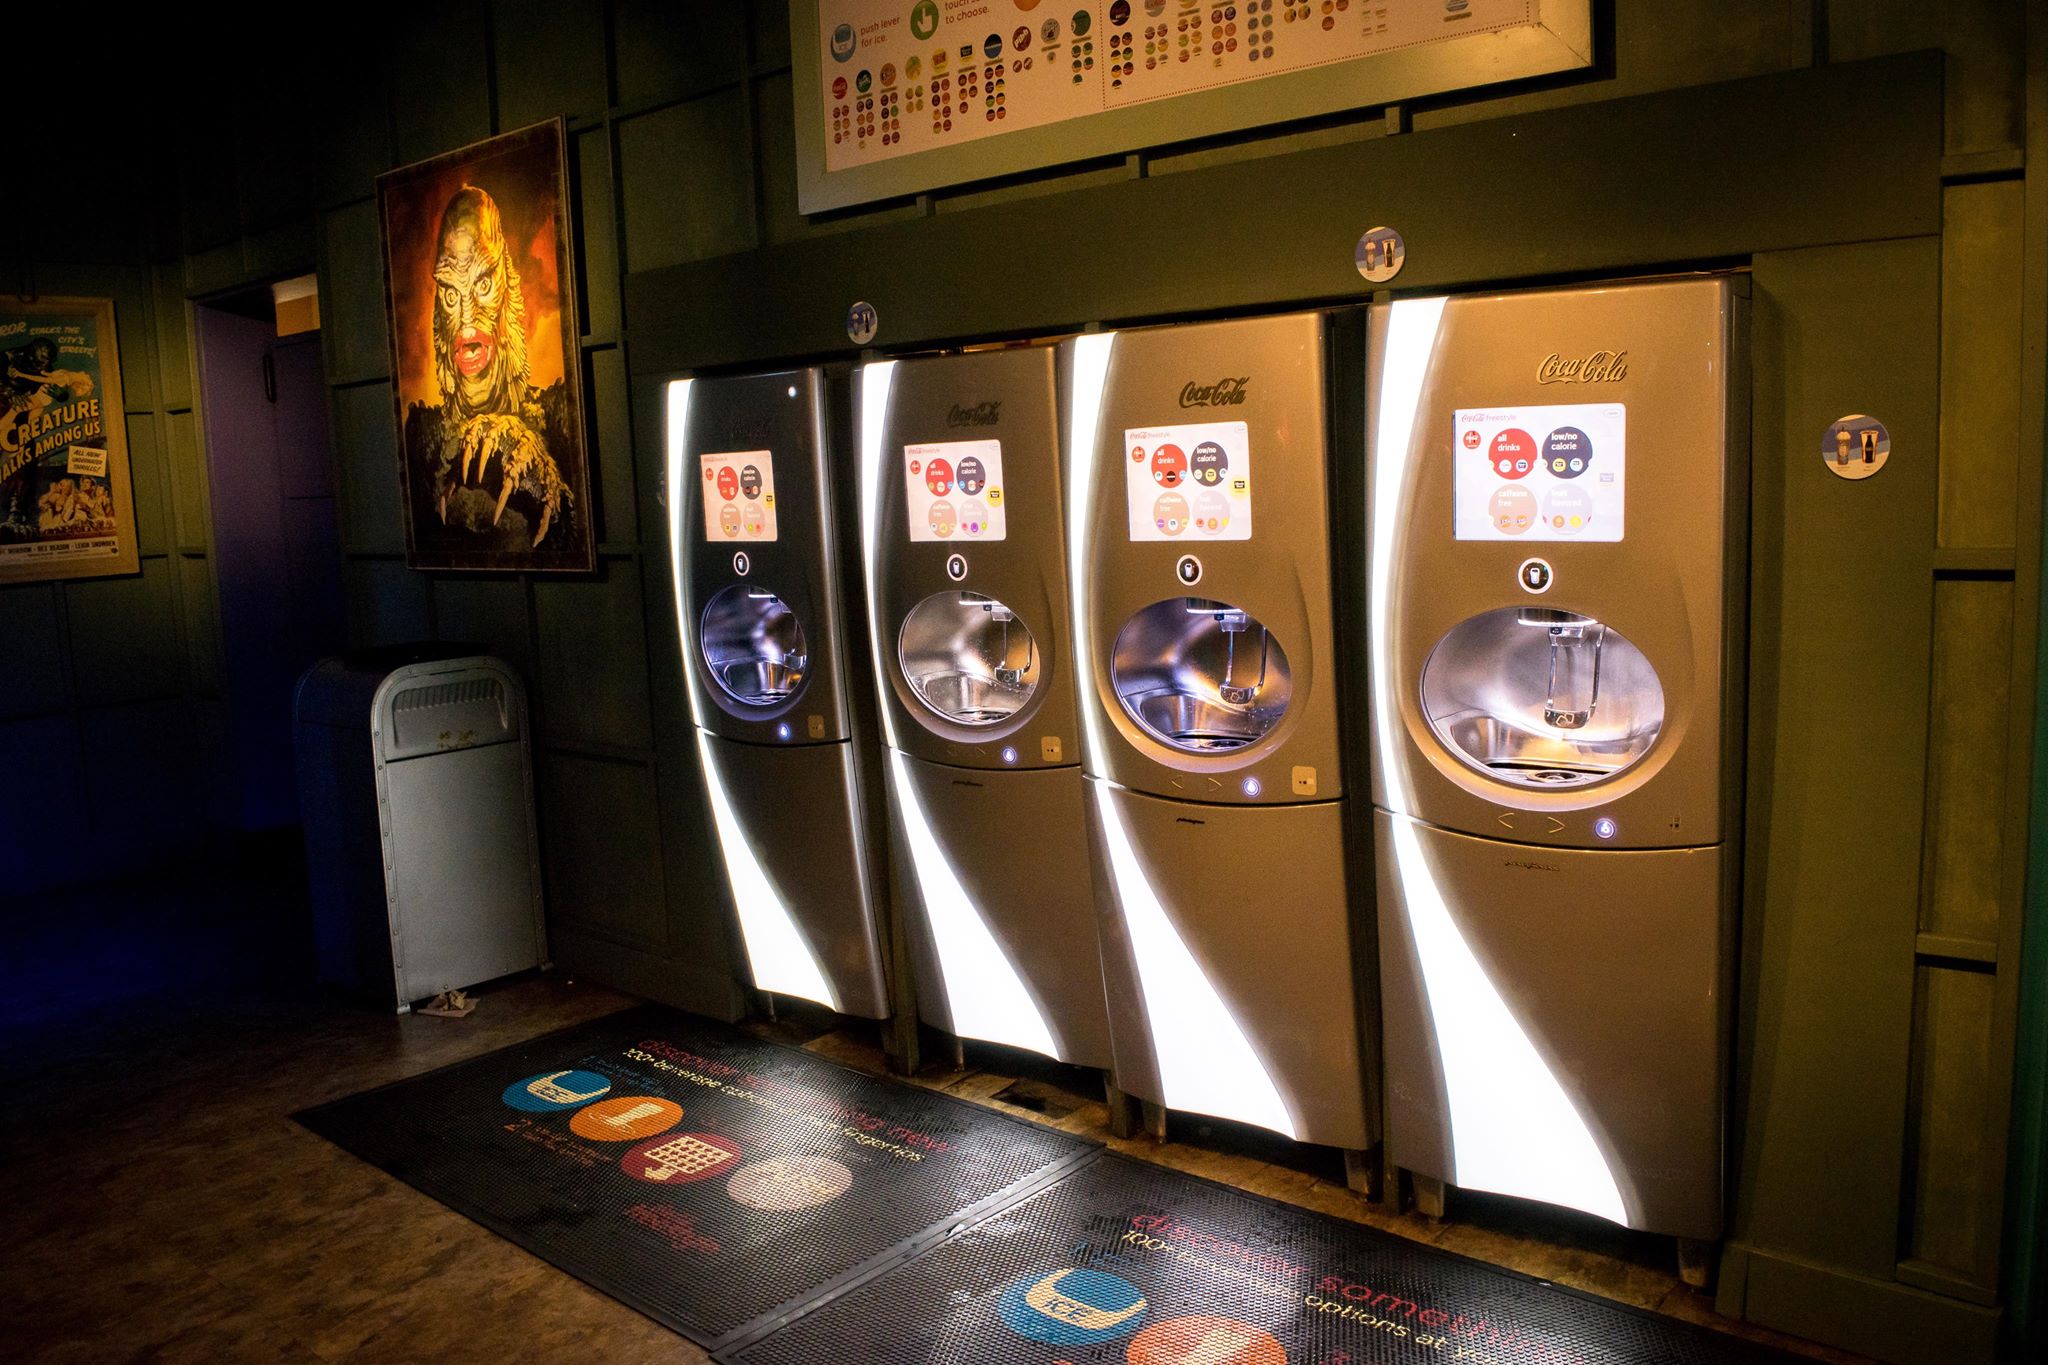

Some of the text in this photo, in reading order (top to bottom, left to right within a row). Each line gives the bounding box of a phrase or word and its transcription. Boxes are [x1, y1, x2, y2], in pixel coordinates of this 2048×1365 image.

[945, 6, 990, 24] to choose.
[861, 16, 900, 36] push lever
[861, 38, 872, 48] for
[1536, 349, 1629, 386] Coca-Cola
[0, 399, 100, 453] CREATURE
[1497, 433, 1508, 442] all
[1551, 432, 1578, 441] low/no
[0, 420, 101, 485] ALKS AMONG US
[1497, 443, 1521, 452] drinks
[1551, 442, 1578, 451] calorie
[1303, 1294, 1449, 1351] options at
